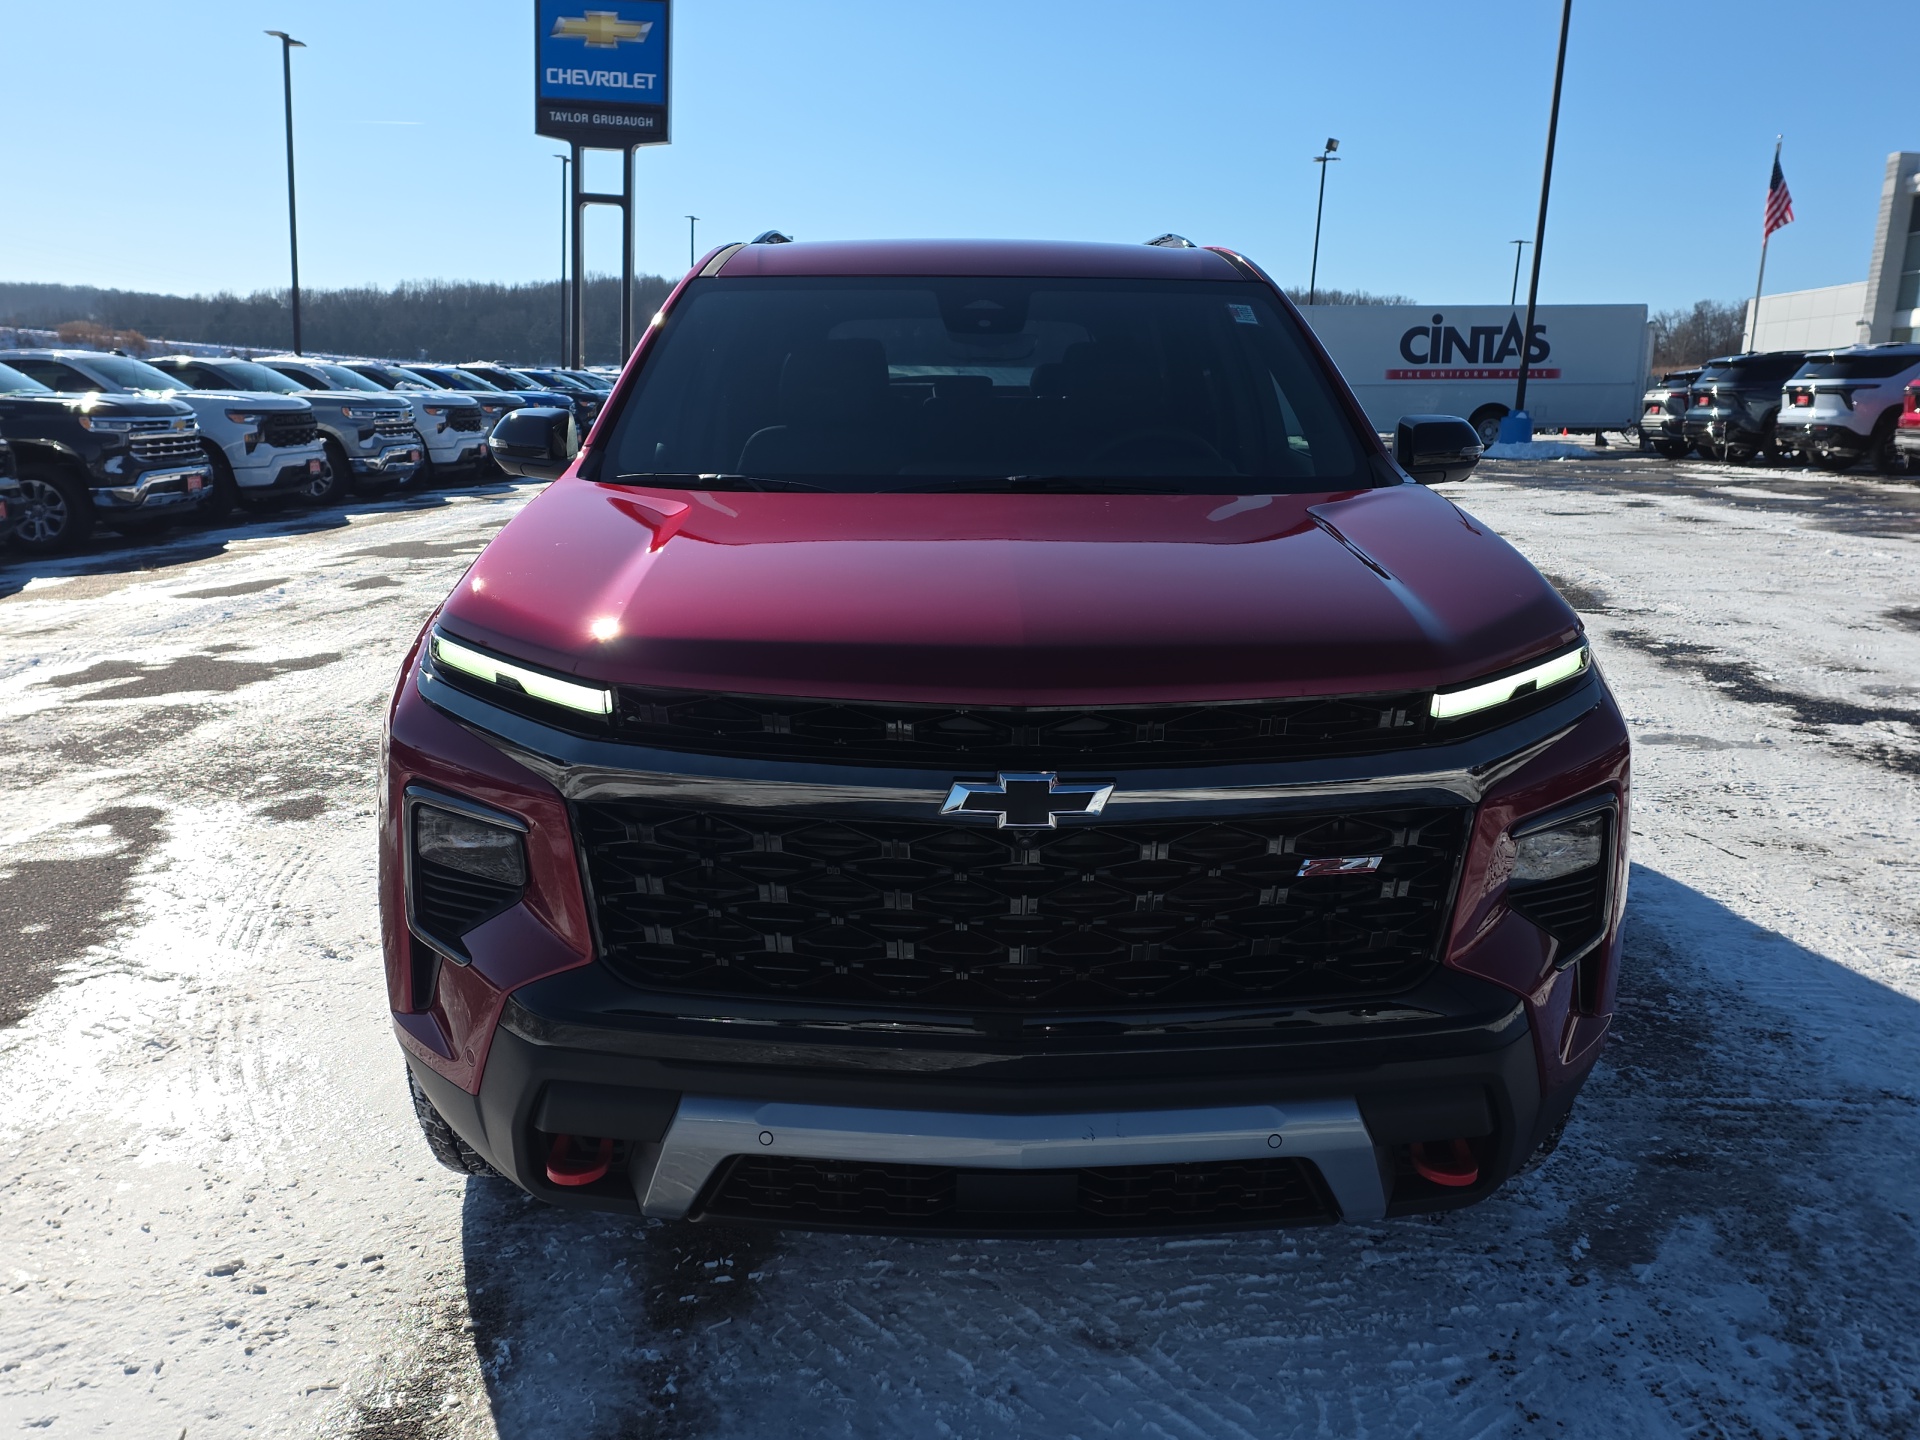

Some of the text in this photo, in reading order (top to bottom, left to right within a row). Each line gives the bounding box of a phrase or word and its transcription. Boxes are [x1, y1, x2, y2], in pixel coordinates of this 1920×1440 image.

[546, 67, 657, 90] CHEVROLET
[549, 111, 654, 127] TAYLOR GRUBAUGH
[1399, 370, 1421, 378] THE
[1430, 370, 1489, 378] UNIFORM
[1296, 856, 1383, 877] Z71
